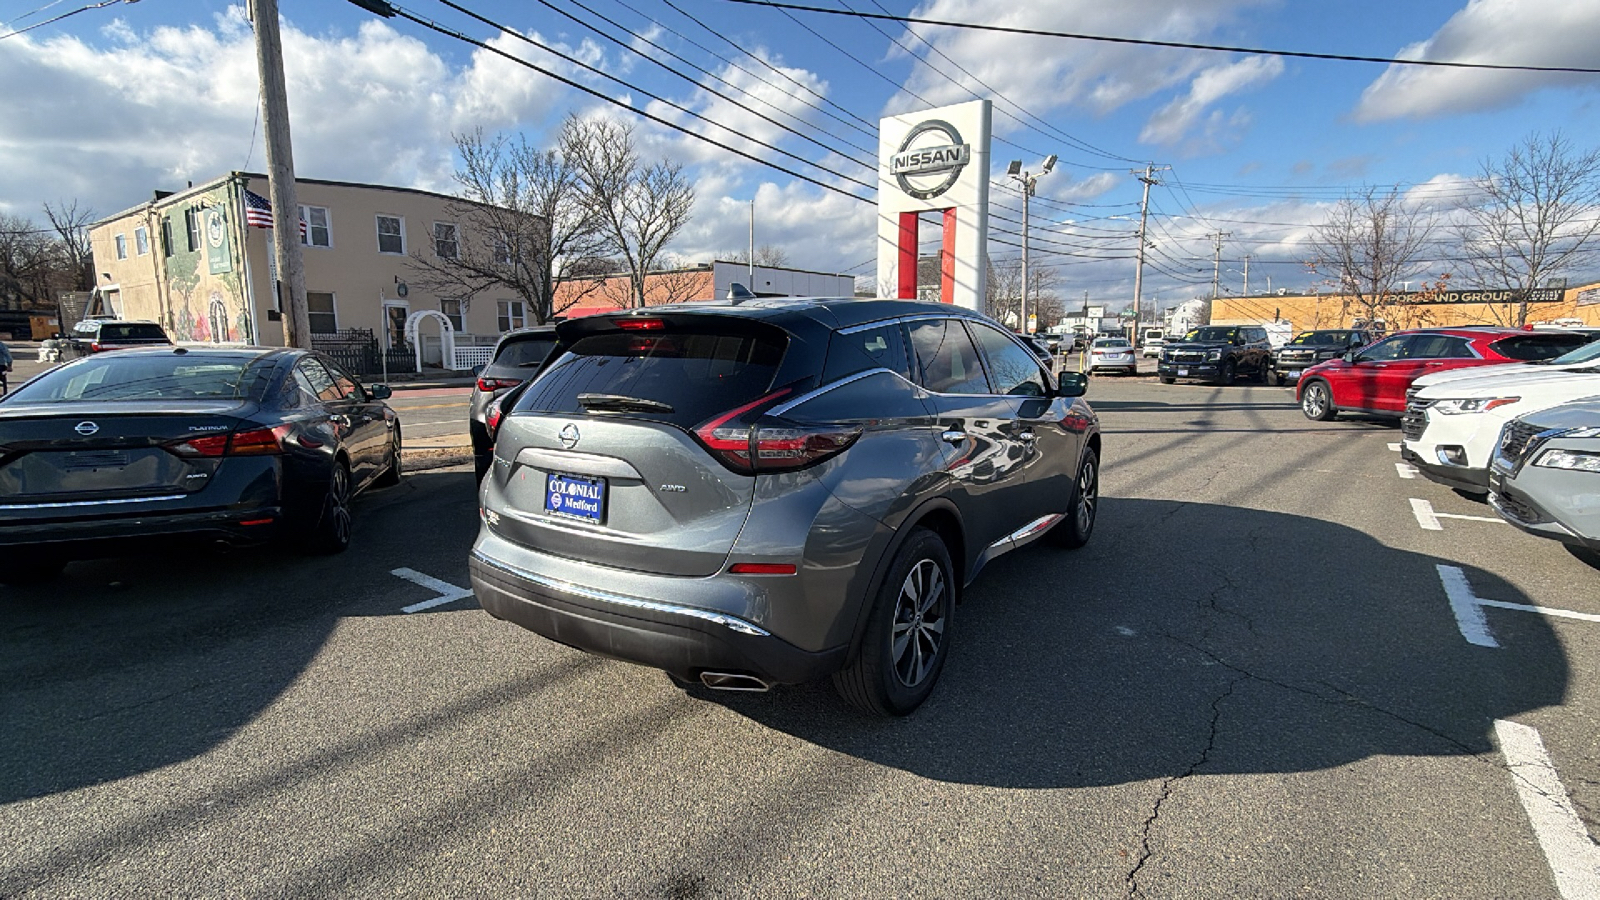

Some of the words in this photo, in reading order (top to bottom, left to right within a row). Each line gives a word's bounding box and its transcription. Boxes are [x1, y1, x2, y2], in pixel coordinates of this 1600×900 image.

[894, 147, 960, 169] NISSAN
[1388, 293, 1459, 303] PORLAND
[1461, 291, 1513, 302] GROUP
[549, 479, 601, 500] COLONIAL
[659, 484, 687, 492] AWD
[564, 496, 598, 513] Medford
